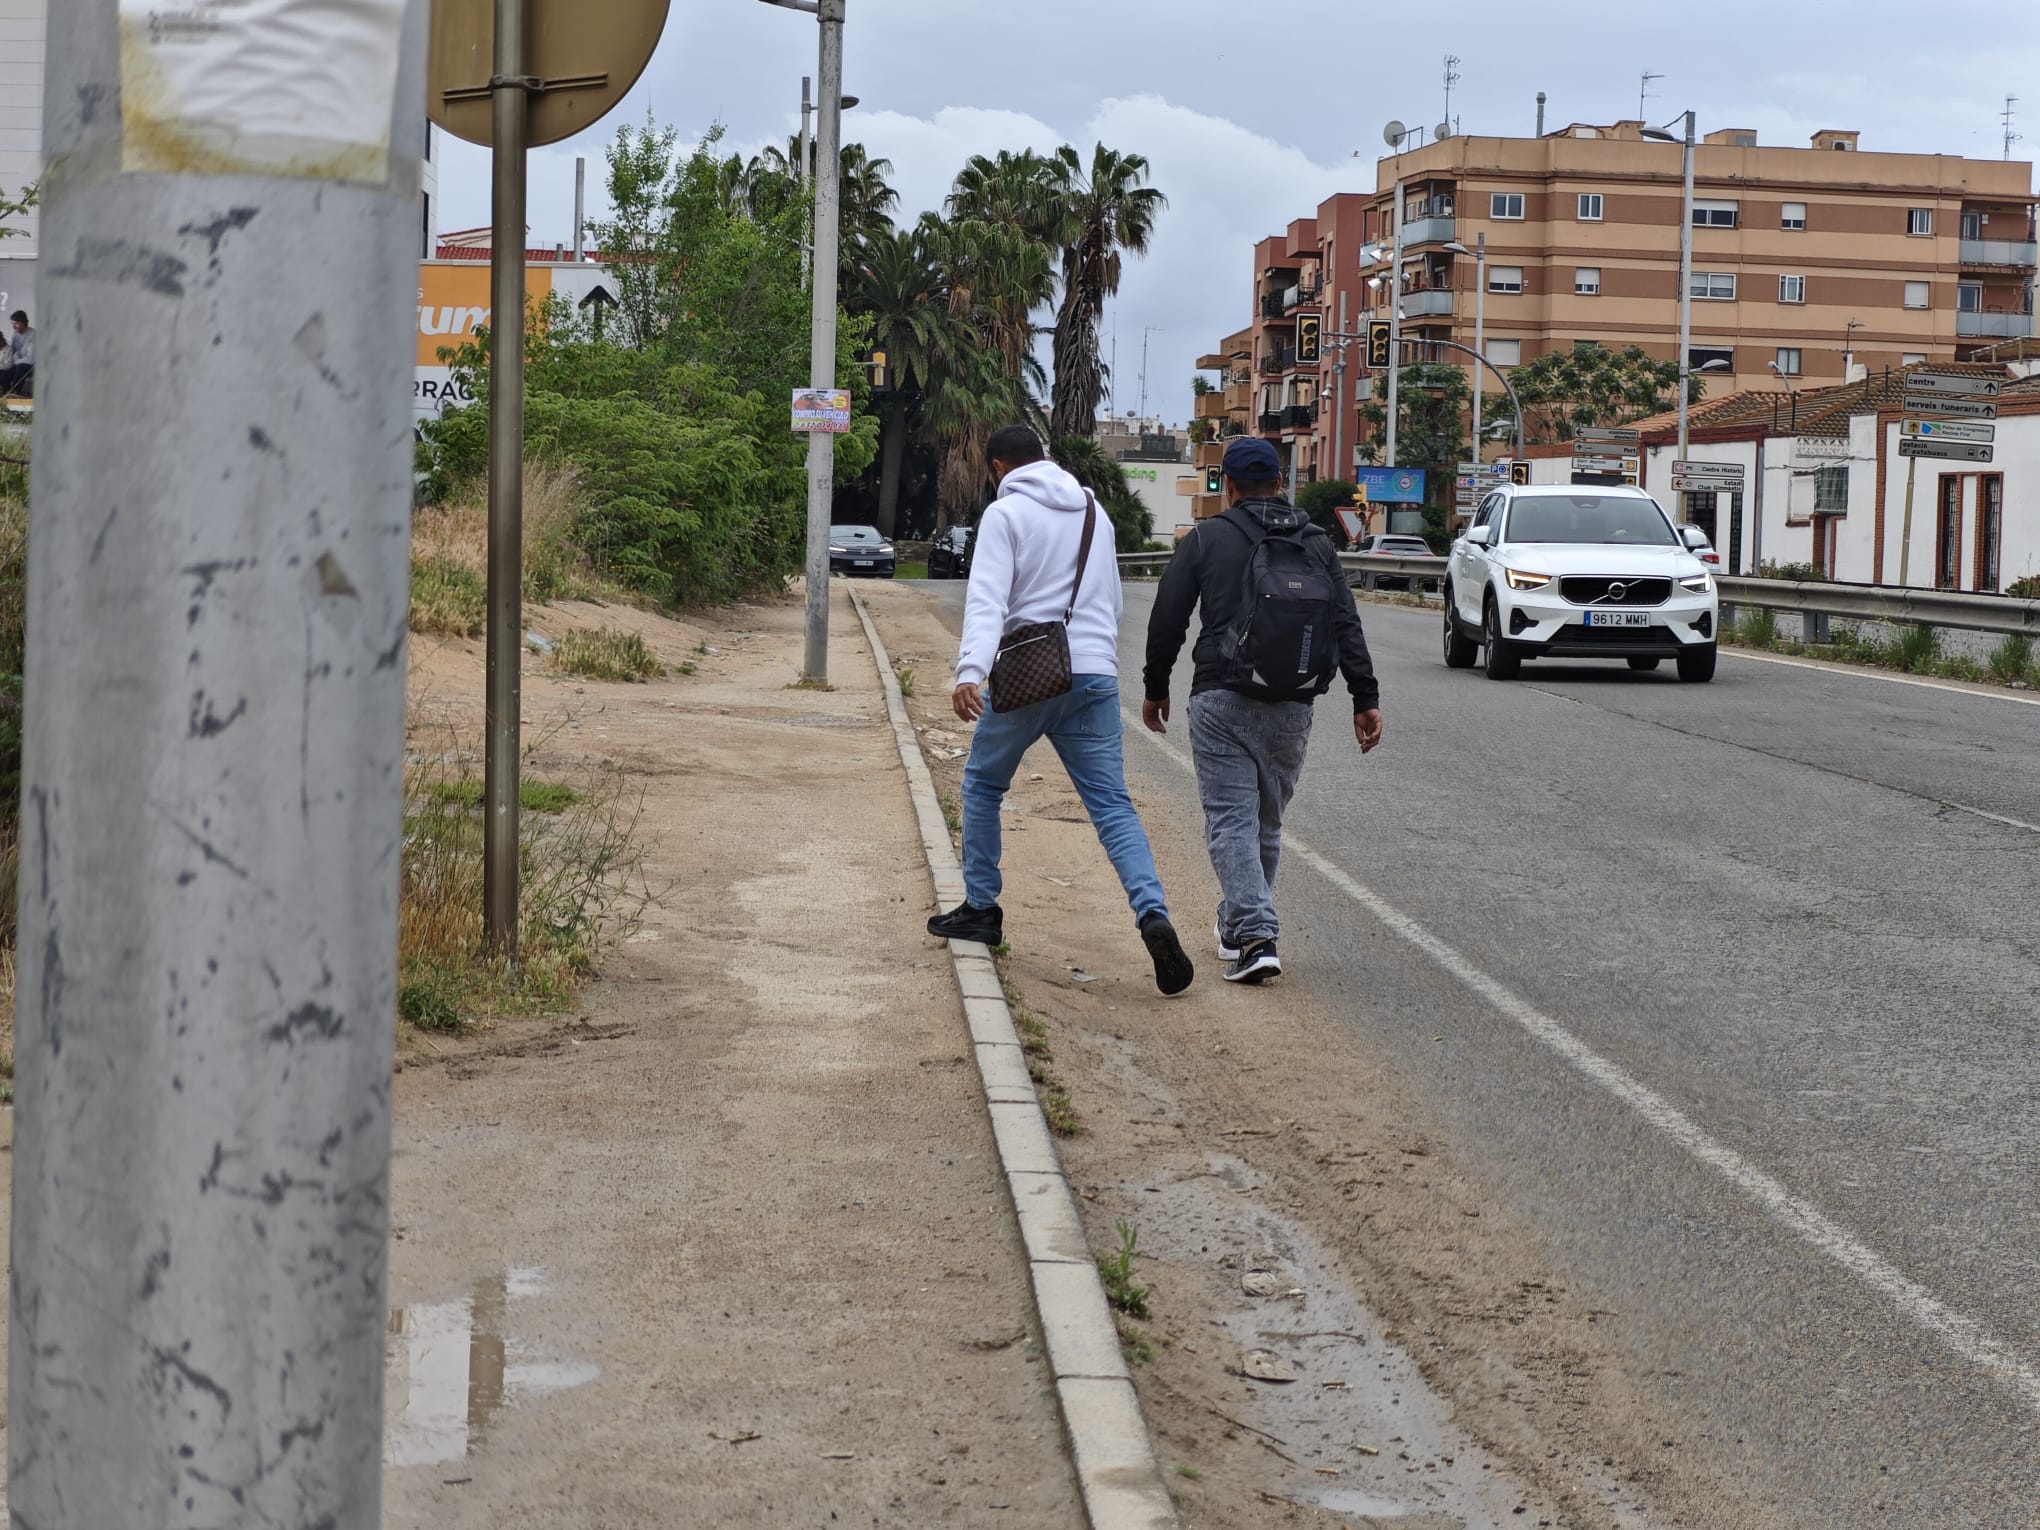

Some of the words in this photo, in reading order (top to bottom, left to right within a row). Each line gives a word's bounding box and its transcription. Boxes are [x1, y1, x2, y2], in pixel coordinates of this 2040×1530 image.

[1908, 378, 1935, 386] centre
[1907, 400, 1937, 409] serveis
[1941, 403, 1979, 413] funeraris
[1912, 449, 1947, 457] autobusos
[1363, 474, 1385, 484] ZBE
[1593, 614, 1622, 625] 9612
[1625, 615, 1647, 625] MMH
